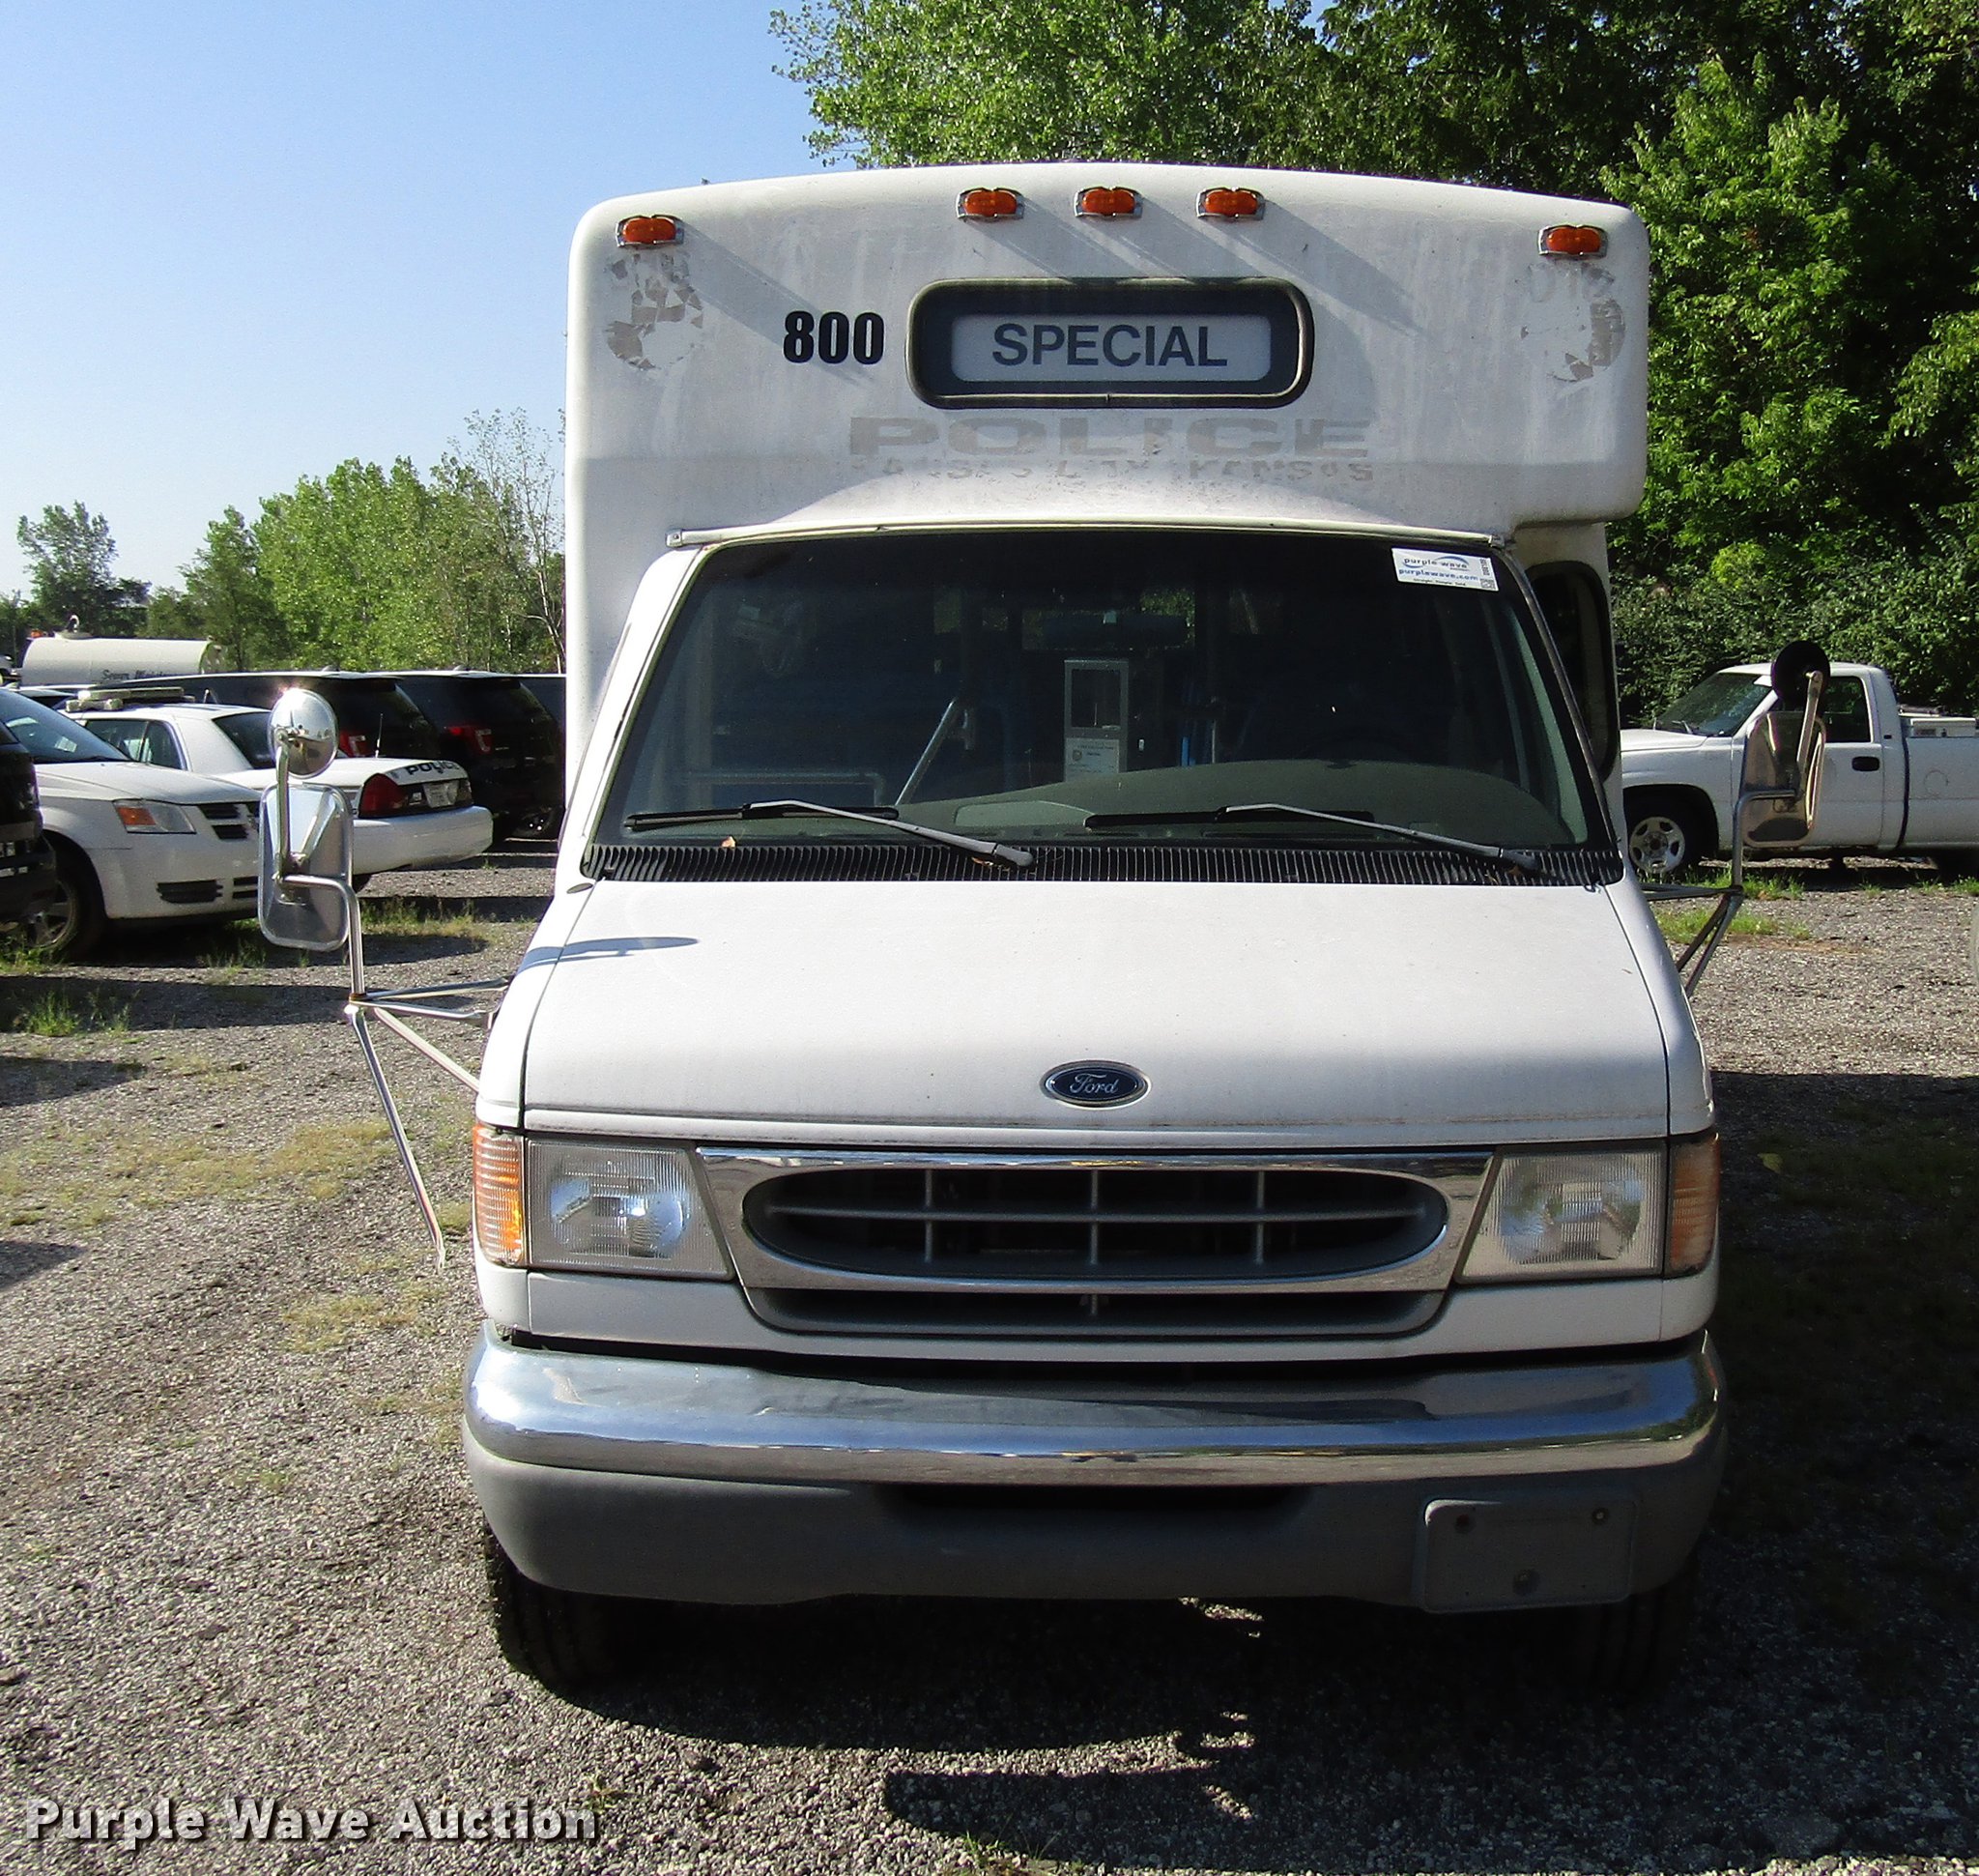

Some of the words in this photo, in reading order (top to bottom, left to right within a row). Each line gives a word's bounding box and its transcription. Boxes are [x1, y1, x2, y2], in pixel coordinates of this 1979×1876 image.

[783, 310, 885, 364] 800
[991, 322, 1228, 368] SPECIAL
[849, 417, 1371, 457] POLICE
[1398, 568, 1479, 581] purplewave.com
[1403, 558, 1438, 566] purple
[1070, 1072, 1120, 1094] Ford
